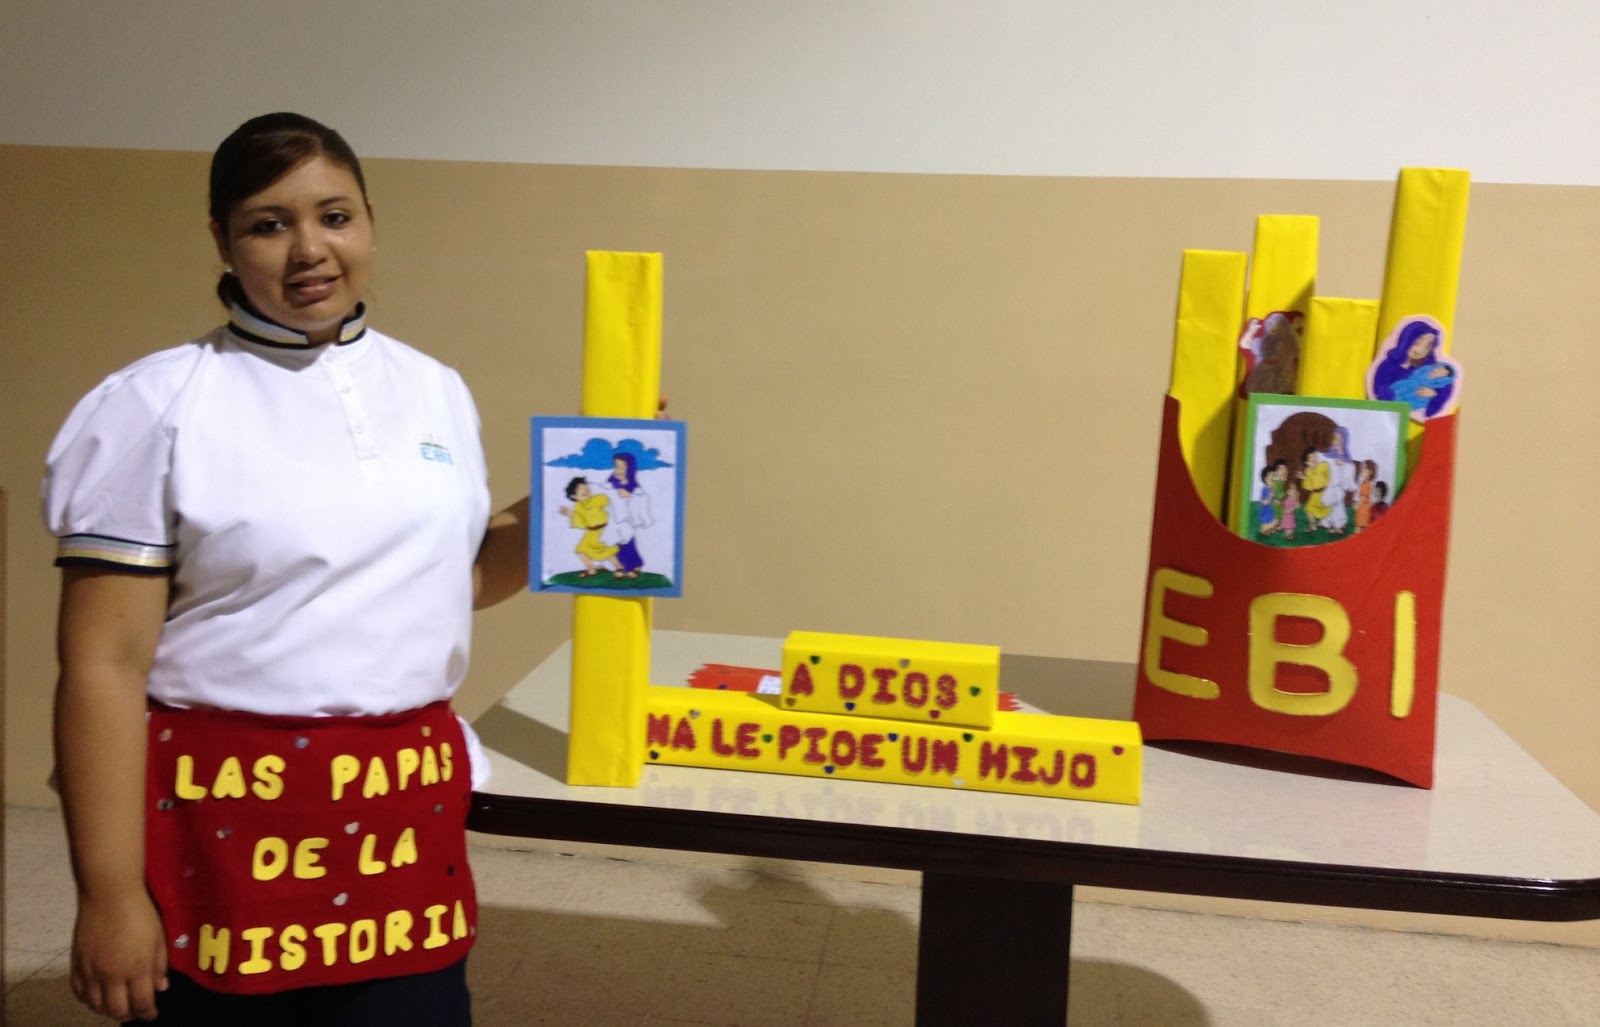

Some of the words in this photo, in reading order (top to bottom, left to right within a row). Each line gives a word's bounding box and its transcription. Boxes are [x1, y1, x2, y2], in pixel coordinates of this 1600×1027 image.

[1144, 567, 1418, 718] EBI
[788, 662, 815, 696] A
[838, 663, 959, 709] DIOS
[175, 754, 287, 801] LAS
[711, 718, 762, 758] LE
[901, 735, 960, 775] UN
[979, 740, 1097, 789] HIJO
[252, 836, 330, 881] DE
[358, 826, 418, 876] LA
[198, 899, 468, 975] HISTORIA
